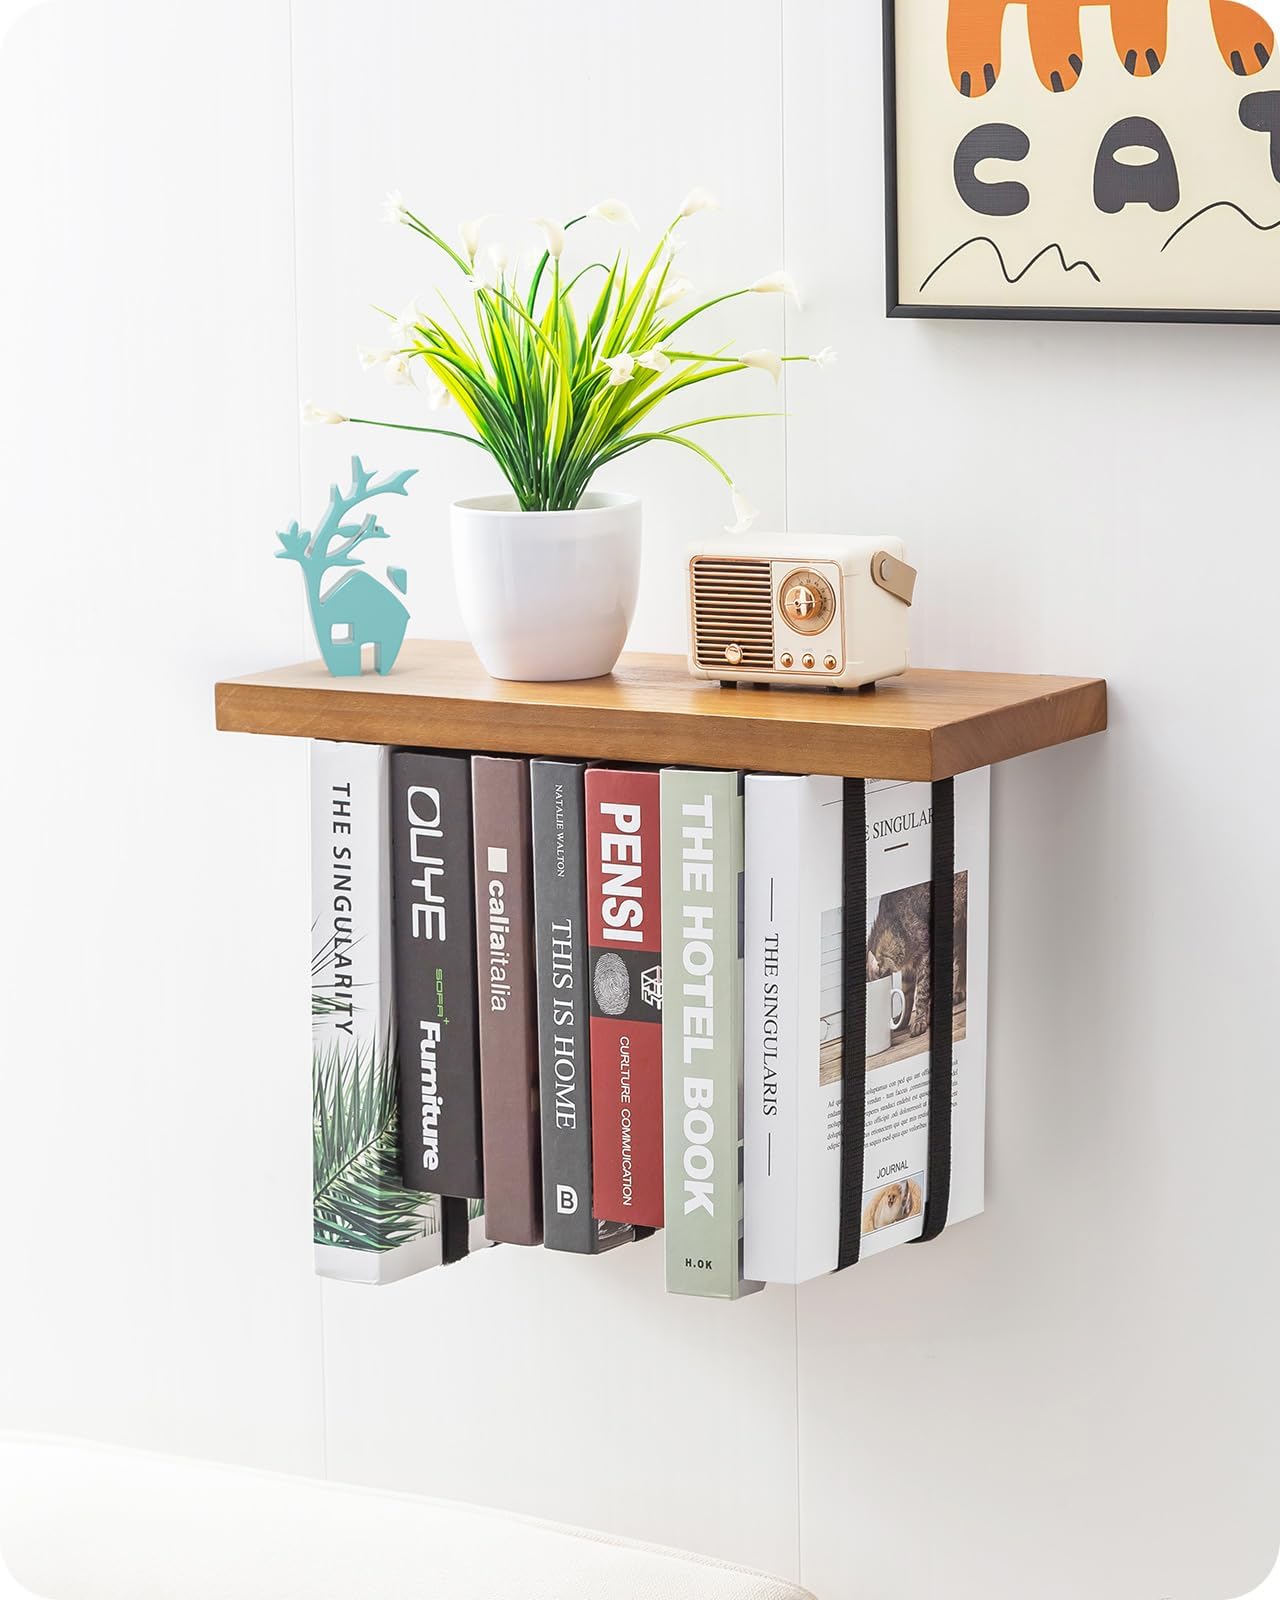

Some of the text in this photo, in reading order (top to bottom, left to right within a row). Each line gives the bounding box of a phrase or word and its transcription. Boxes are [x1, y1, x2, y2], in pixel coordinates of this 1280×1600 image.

[554, 783, 565, 878] NATALIE WALTON
[600, 802, 644, 943] PENSI
[872, 808, 934, 839] SINGULAR
[332, 782, 353, 1035] THE SINGULARITY
[551, 918, 576, 1130] THIS IS HOME
[682, 794, 715, 1218] THE HOTEL BOOK
[763, 933, 779, 1116] THE SINGULARIS
[420, 1020, 444, 1171] Furniture
[620, 1036, 632, 1206] CURLTURE COMMUICATION
[876, 1159, 909, 1180] JOURNAL
[685, 1258, 713, 1270] H.OK
